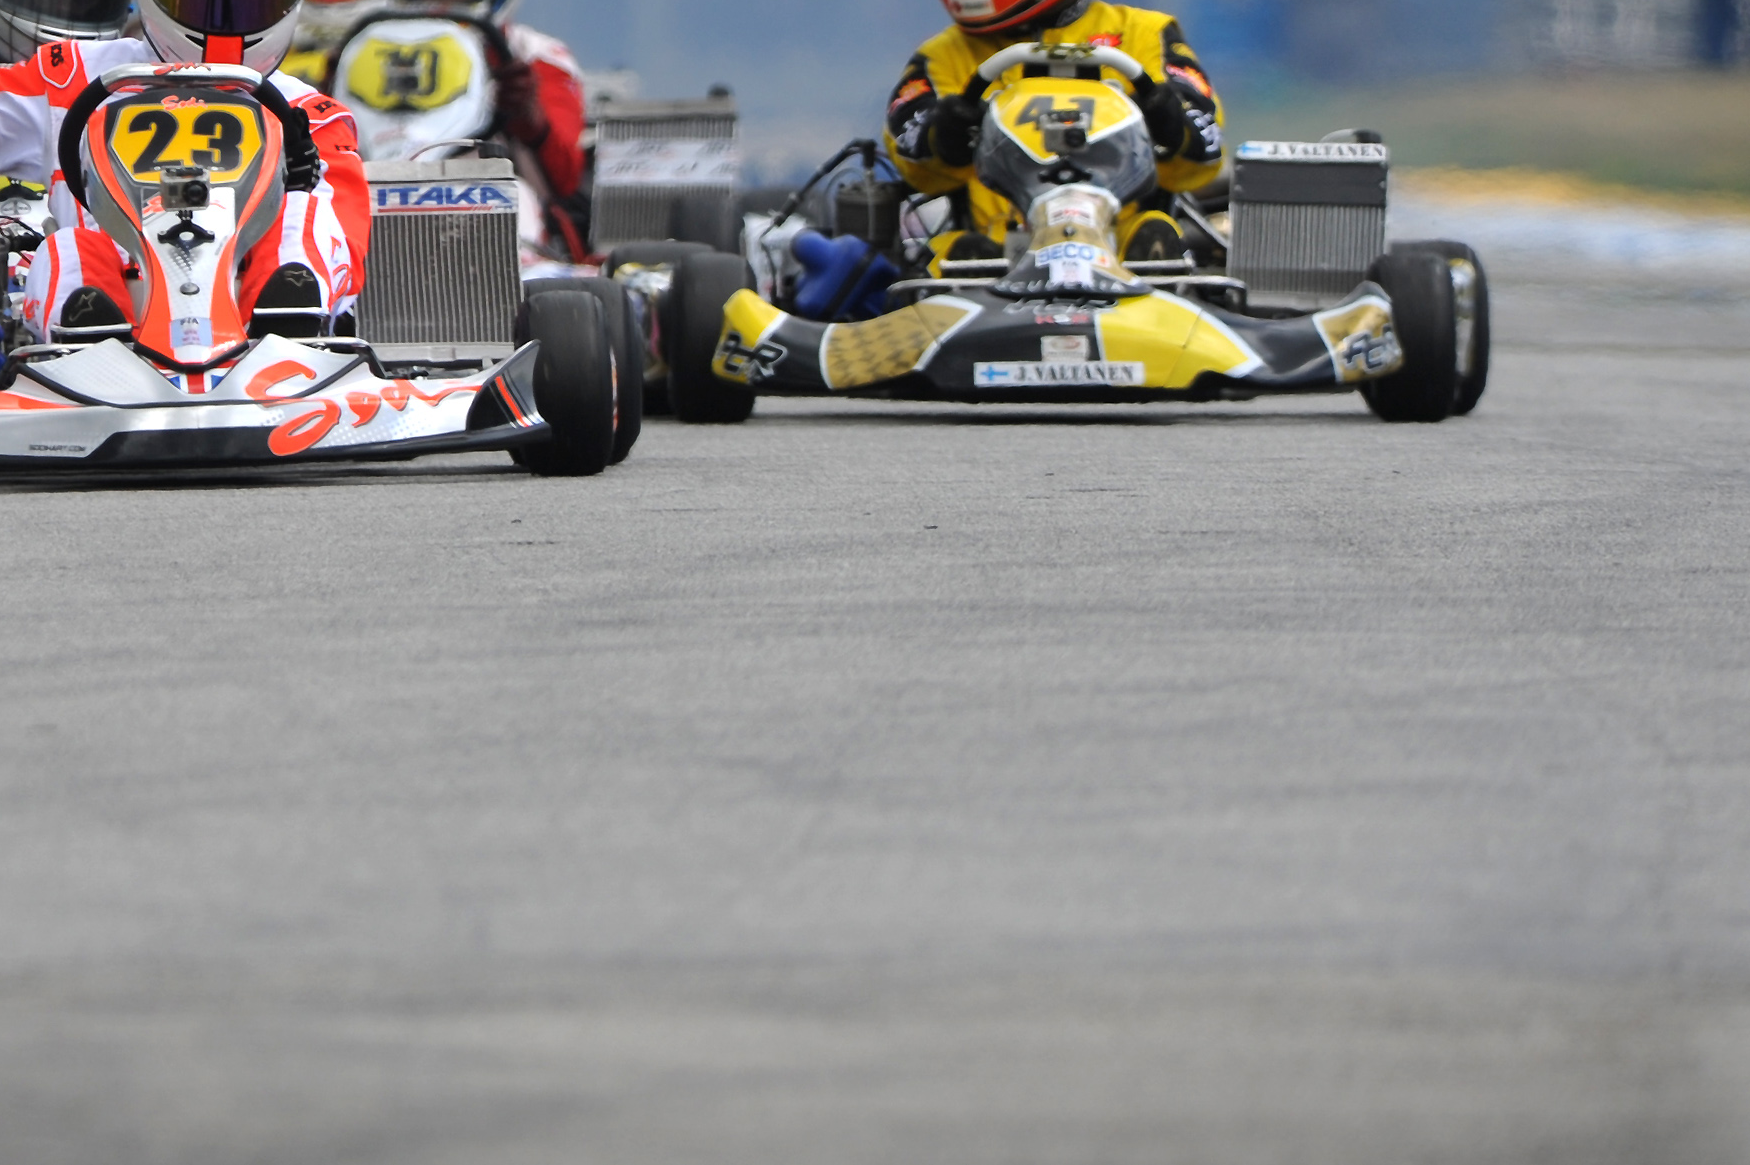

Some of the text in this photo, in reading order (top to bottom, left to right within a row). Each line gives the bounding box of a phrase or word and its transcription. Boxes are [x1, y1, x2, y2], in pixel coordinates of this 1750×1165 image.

[128, 110, 244, 174] 23
[377, 186, 512, 207] ITAKA
[1037, 243, 1095, 264] SECO
[245, 359, 483, 457] Sodi
